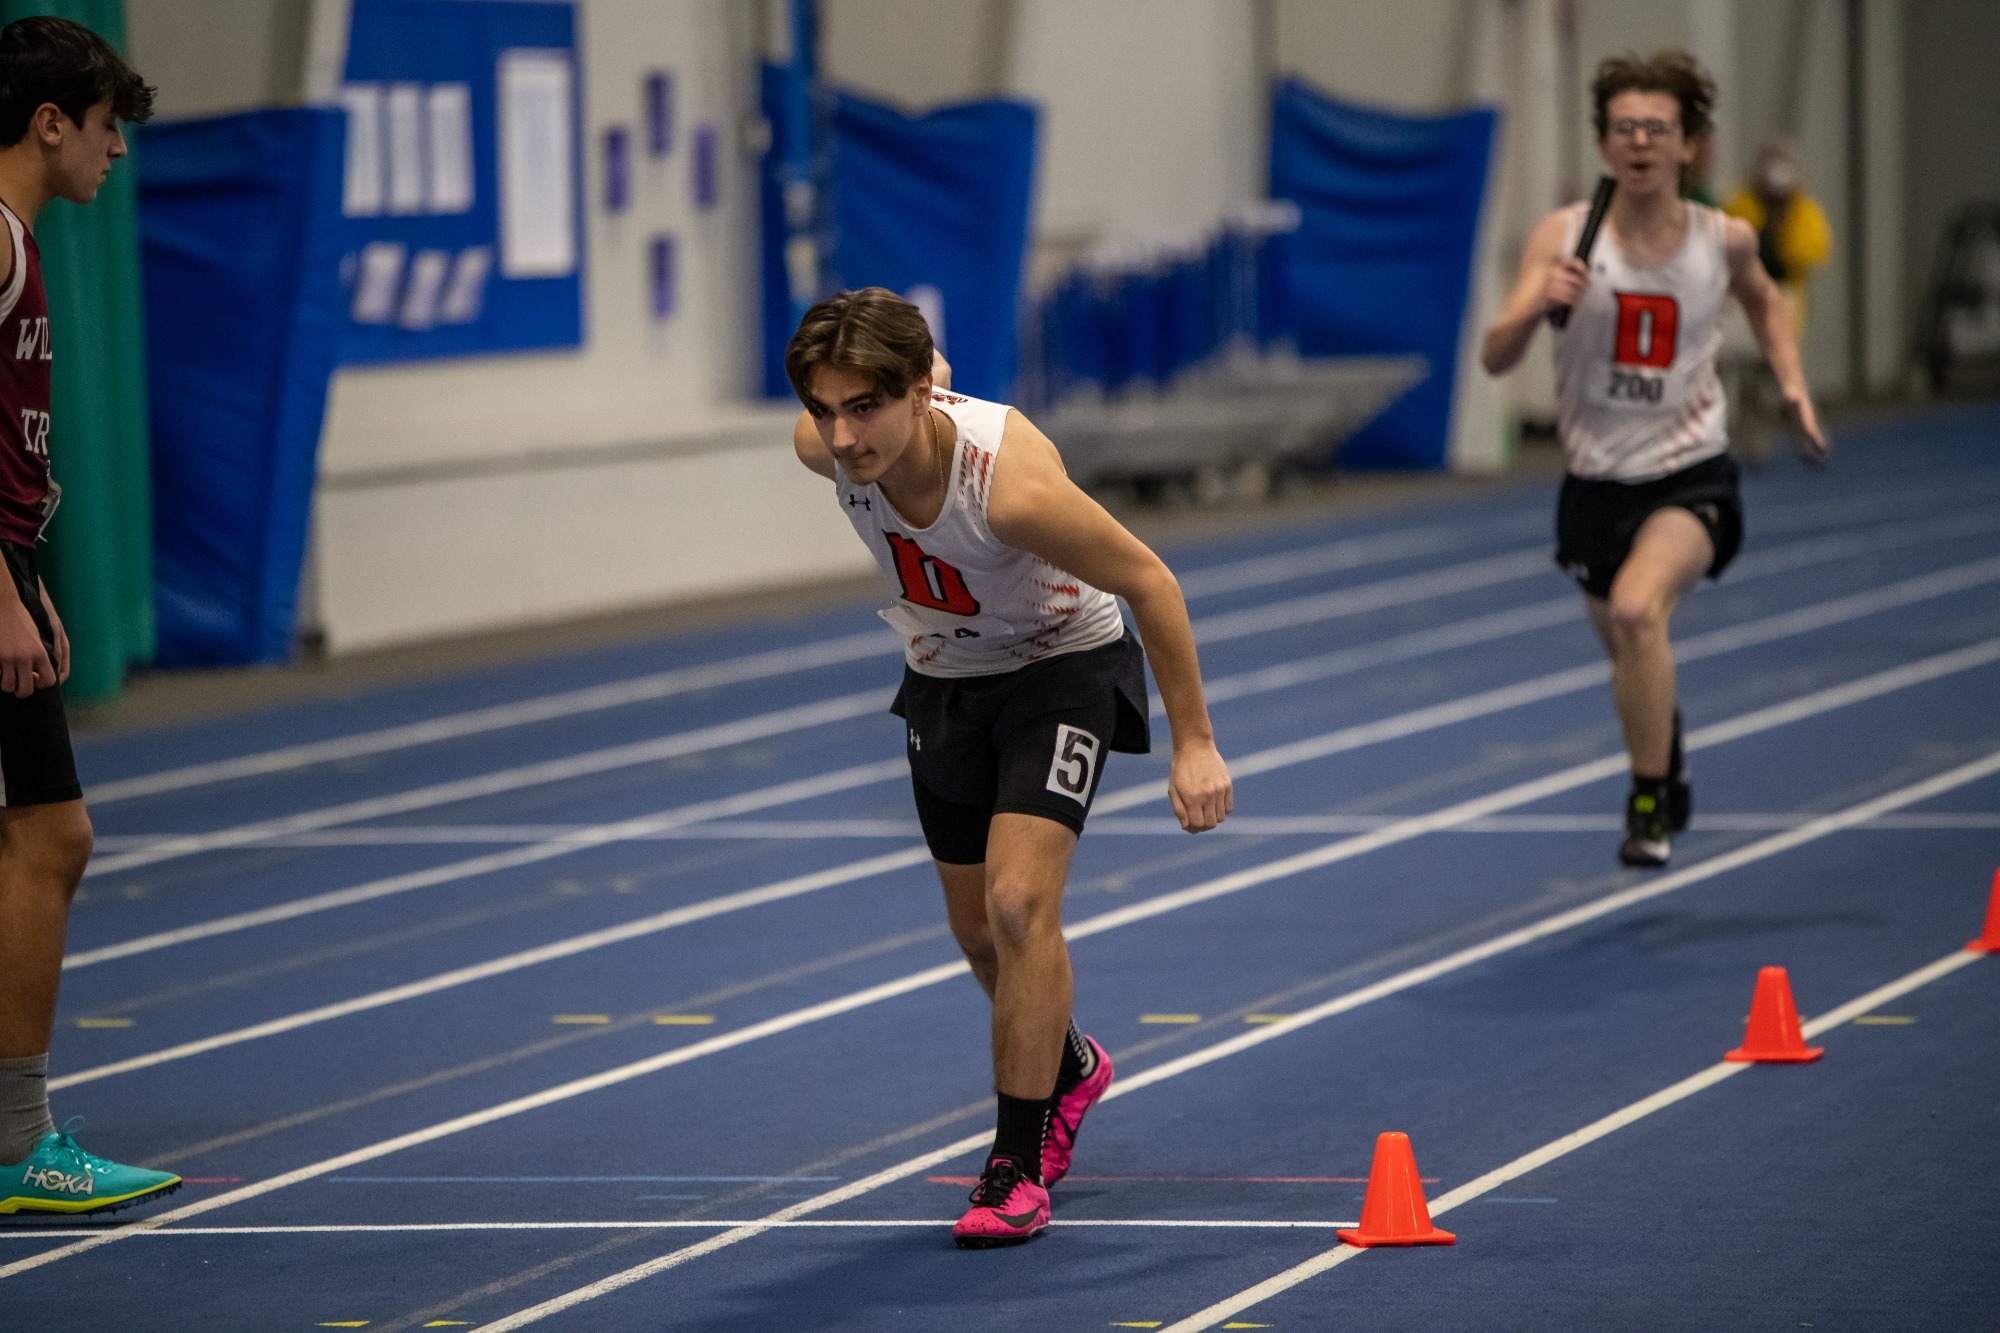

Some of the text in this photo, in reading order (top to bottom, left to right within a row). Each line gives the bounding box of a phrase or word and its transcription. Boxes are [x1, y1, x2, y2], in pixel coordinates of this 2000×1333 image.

[1612, 289, 1680, 369] D
[881, 528, 980, 616] D
[1057, 730, 1094, 794] 5
[22, 1165, 94, 1195] HOKA
